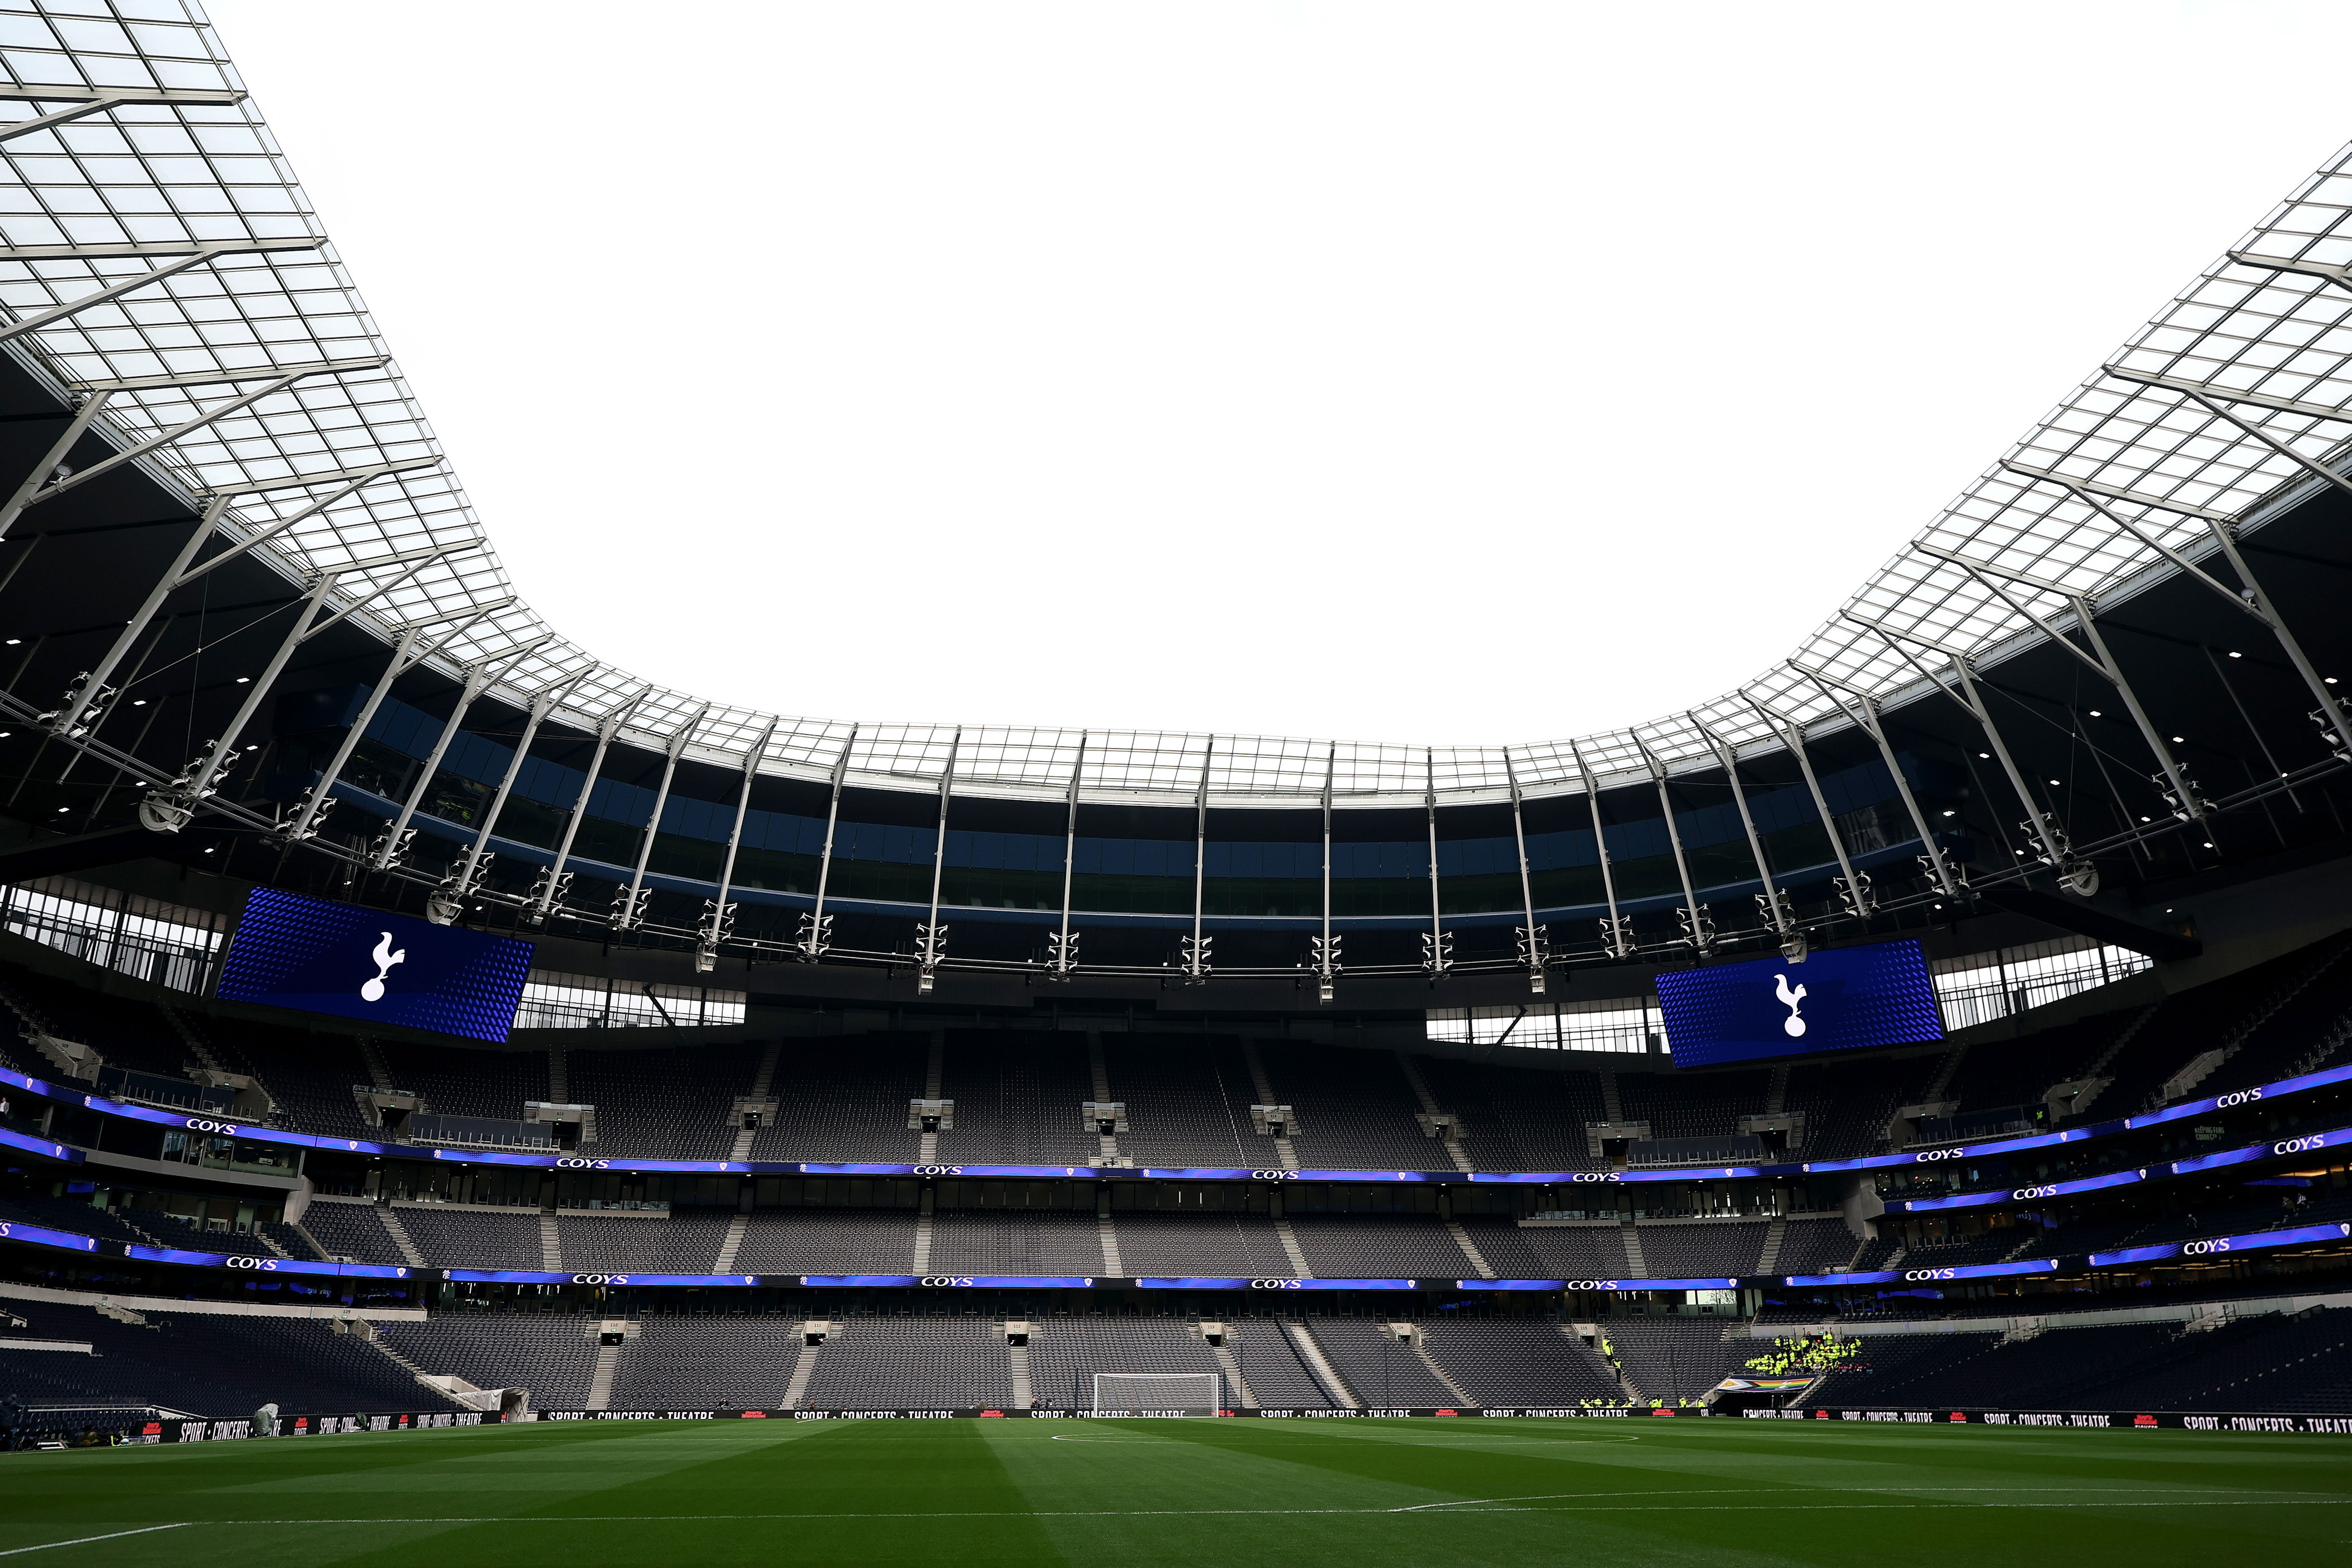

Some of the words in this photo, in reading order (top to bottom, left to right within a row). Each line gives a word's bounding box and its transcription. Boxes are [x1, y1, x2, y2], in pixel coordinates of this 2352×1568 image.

[2217, 1088, 2262, 1108] COYS
[186, 1118, 237, 1135] COYS
[2274, 1135, 2324, 1155] COYS
[1916, 1147, 1963, 1162] COYS
[556, 1157, 610, 1169] COYS
[913, 1165, 963, 1175] COYS
[1252, 1170, 1299, 1179] COYS
[1572, 1172, 1620, 1182] COYS
[2013, 1184, 2057, 1199] COYS
[2184, 1238, 2230, 1255] COYS
[226, 1256, 278, 1271] COYS
[572, 1274, 629, 1284] COYS
[1905, 1268, 1954, 1281] COYS
[921, 1277, 974, 1287] COYS
[1251, 1279, 1302, 1289] COYS
[1567, 1280, 1618, 1290] COYS
[550, 1411, 585, 1421] SPORT
[597, 1411, 655, 1420] CONCERTS
[667, 1411, 714, 1420] THEATRE
[794, 1411, 830, 1420] SPORT
[841, 1411, 896, 1419] CONCERTS
[908, 1410, 954, 1419] THEATRE
[1031, 1410, 1065, 1419] SPORT
[1260, 1410, 1294, 1418] SPORT
[1305, 1410, 1357, 1419] CONCERTS
[1367, 1410, 1410, 1418] THEATRE
[1483, 1409, 1515, 1418] SPORT
[1526, 1409, 1576, 1418] CONCERTS
[1586, 1409, 1628, 1418] THEATRE
[1780, 1410, 1804, 1420] THEATRE
[1841, 1411, 1860, 1421] SPORT
[1904, 1412, 1933, 1423] THEATRE
[319, 1417, 339, 1436] SPORT
[370, 1415, 391, 1432] THEATRE
[417, 1414, 431, 1429] SPORT
[432, 1413, 452, 1428] CONCERTS
[455, 1413, 483, 1427] THEATRE
[1984, 1413, 2010, 1425] SPORT
[2019, 1414, 2063, 1427] CONCERTS
[2070, 1414, 2110, 1428] THEATRE
[2184, 1416, 2219, 1430] SPORT
[2231, 1417, 2294, 1432] CONCERTS
[179, 1421, 207, 1444] SPORT
[211, 1420, 250, 1442] CONCERTS
